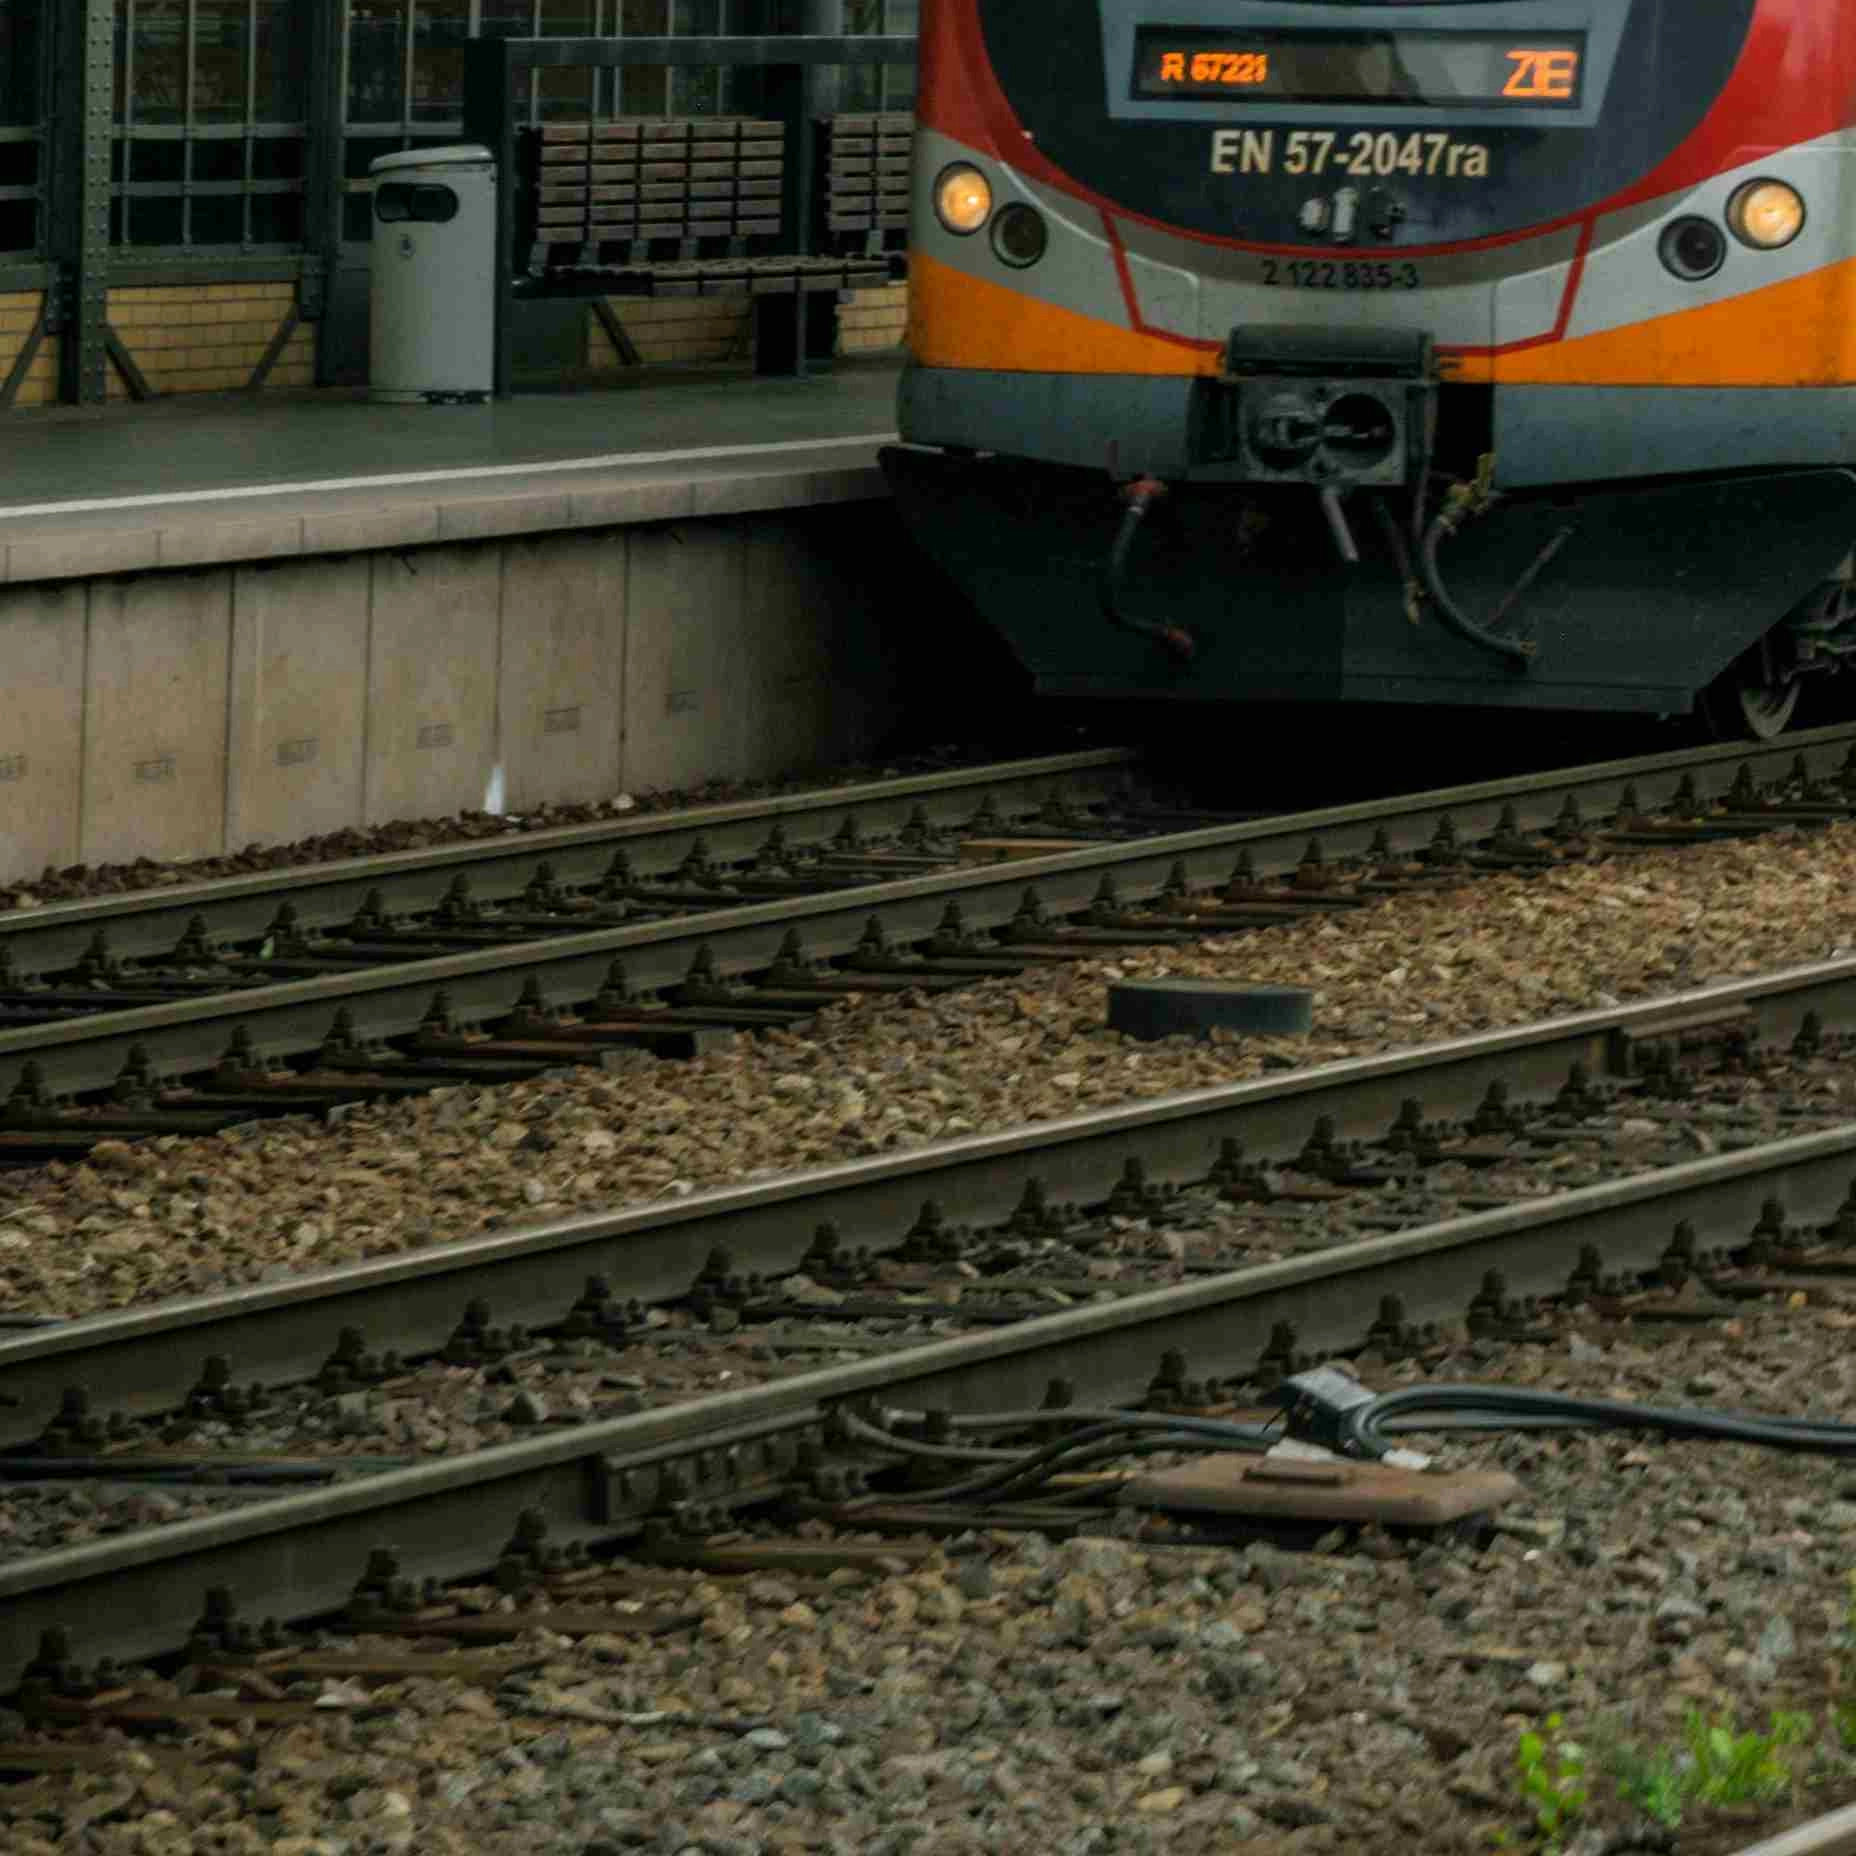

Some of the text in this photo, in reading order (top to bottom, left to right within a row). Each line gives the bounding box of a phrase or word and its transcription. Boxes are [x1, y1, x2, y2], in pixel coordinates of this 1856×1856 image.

[1160, 51, 1185, 82] R
[1209, 129, 1489, 177] EN 57-2047ra
[1262, 259, 1280, 286] 2
